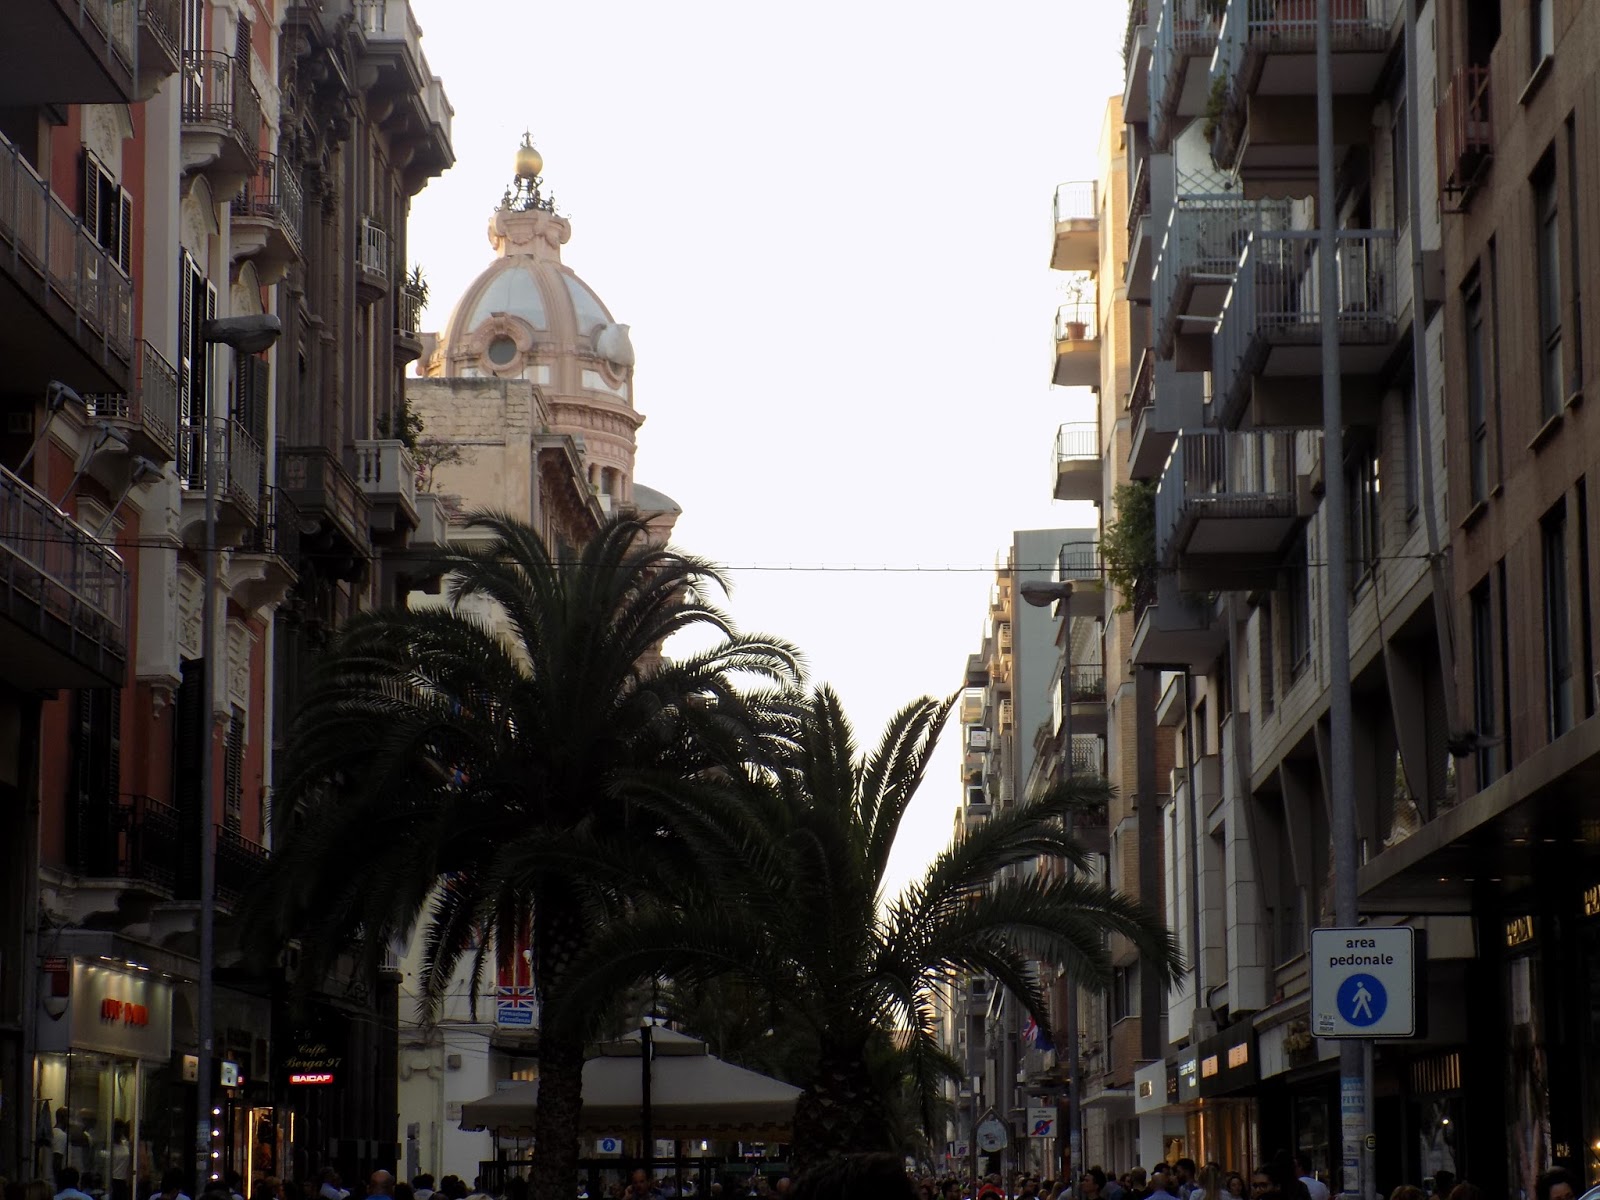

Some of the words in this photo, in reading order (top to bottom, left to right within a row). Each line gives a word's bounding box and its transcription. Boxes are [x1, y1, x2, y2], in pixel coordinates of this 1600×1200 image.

[1346, 939, 1376, 949] area
[1329, 953, 1394, 968] pedonale
[326, 1057, 342, 1068] 97
